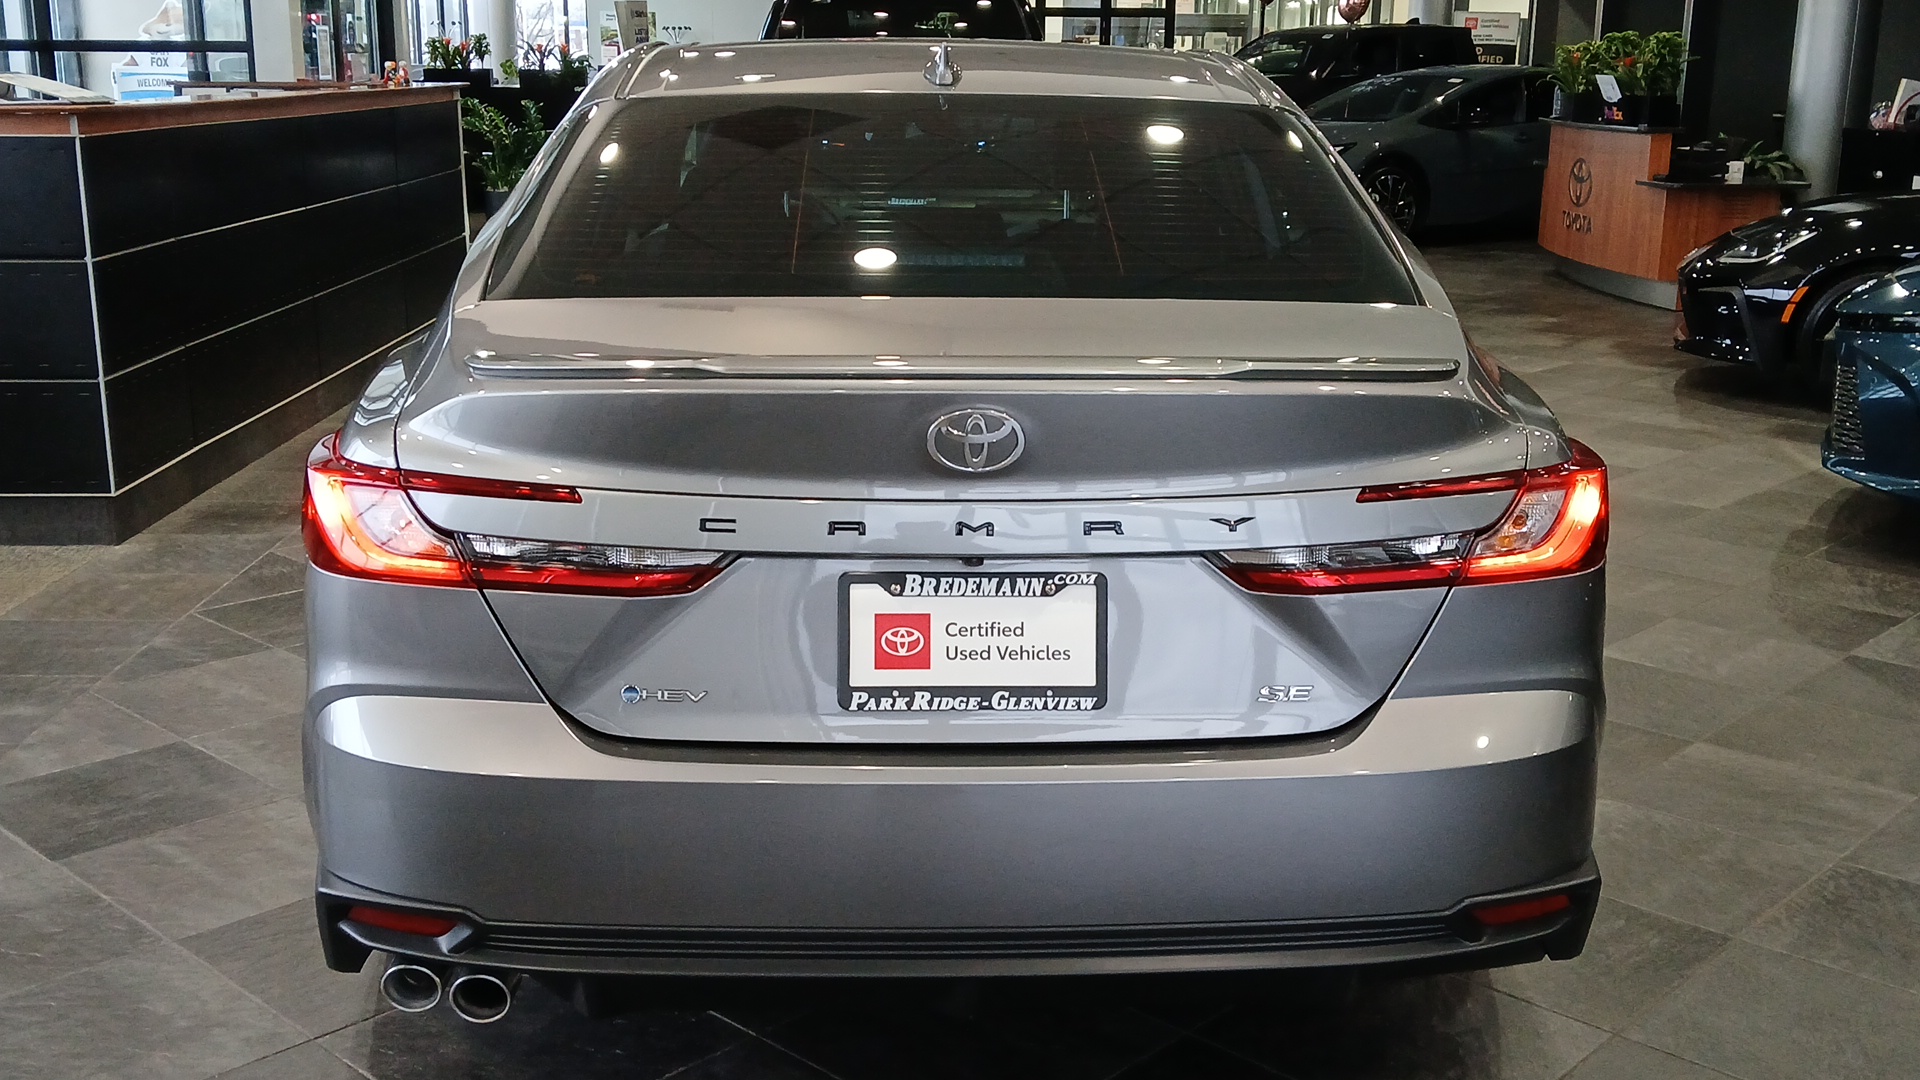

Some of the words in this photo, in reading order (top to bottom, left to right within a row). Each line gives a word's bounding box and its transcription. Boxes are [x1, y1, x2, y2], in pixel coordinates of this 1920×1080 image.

[150, 57, 169, 67] FOX
[1562, 209, 1592, 235] TOYOTA
[699, 516, 1257, 537] CAMRY
[945, 621, 1025, 638] Certified
[945, 645, 991, 661] Used
[996, 645, 1071, 661] Vehicles
[642, 689, 708, 703] HEV
[848, 690, 911, 711] PARK
[1257, 684, 1314, 703] SE
